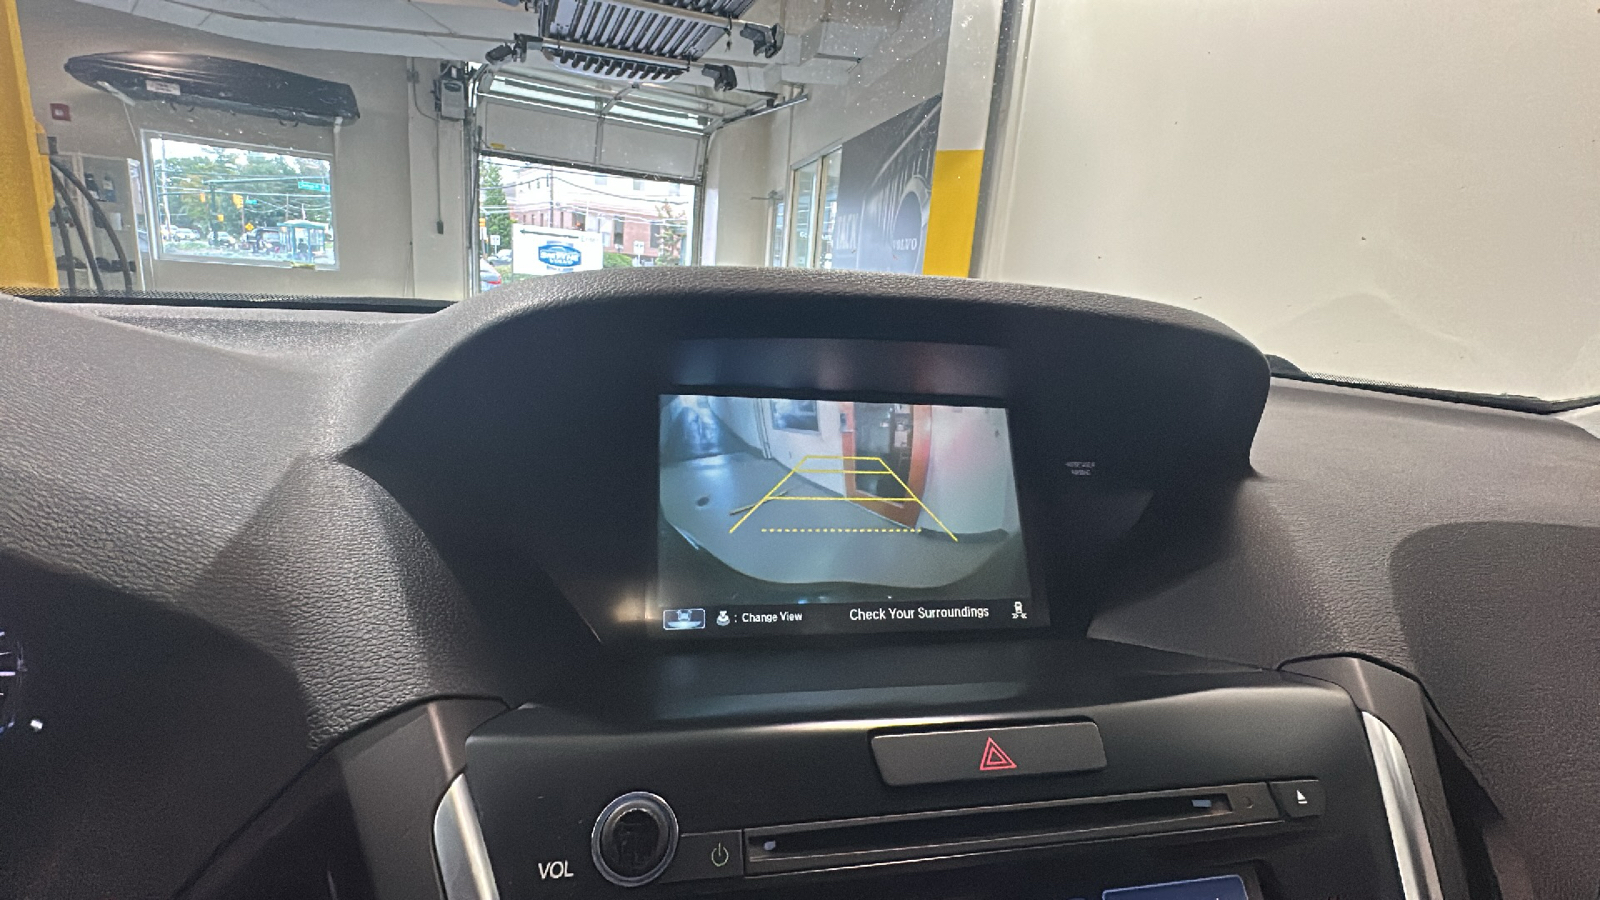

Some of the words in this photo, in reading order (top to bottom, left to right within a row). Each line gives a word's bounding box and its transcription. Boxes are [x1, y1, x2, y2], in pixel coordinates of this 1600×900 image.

[892, 237, 918, 251] VOLVO
[741, 612, 778, 624] Change
[779, 611, 803, 622] View
[849, 607, 887, 621] Check
[888, 607, 915, 620] Your
[917, 605, 990, 619] Surroundings
[537, 859, 575, 880] VOL
